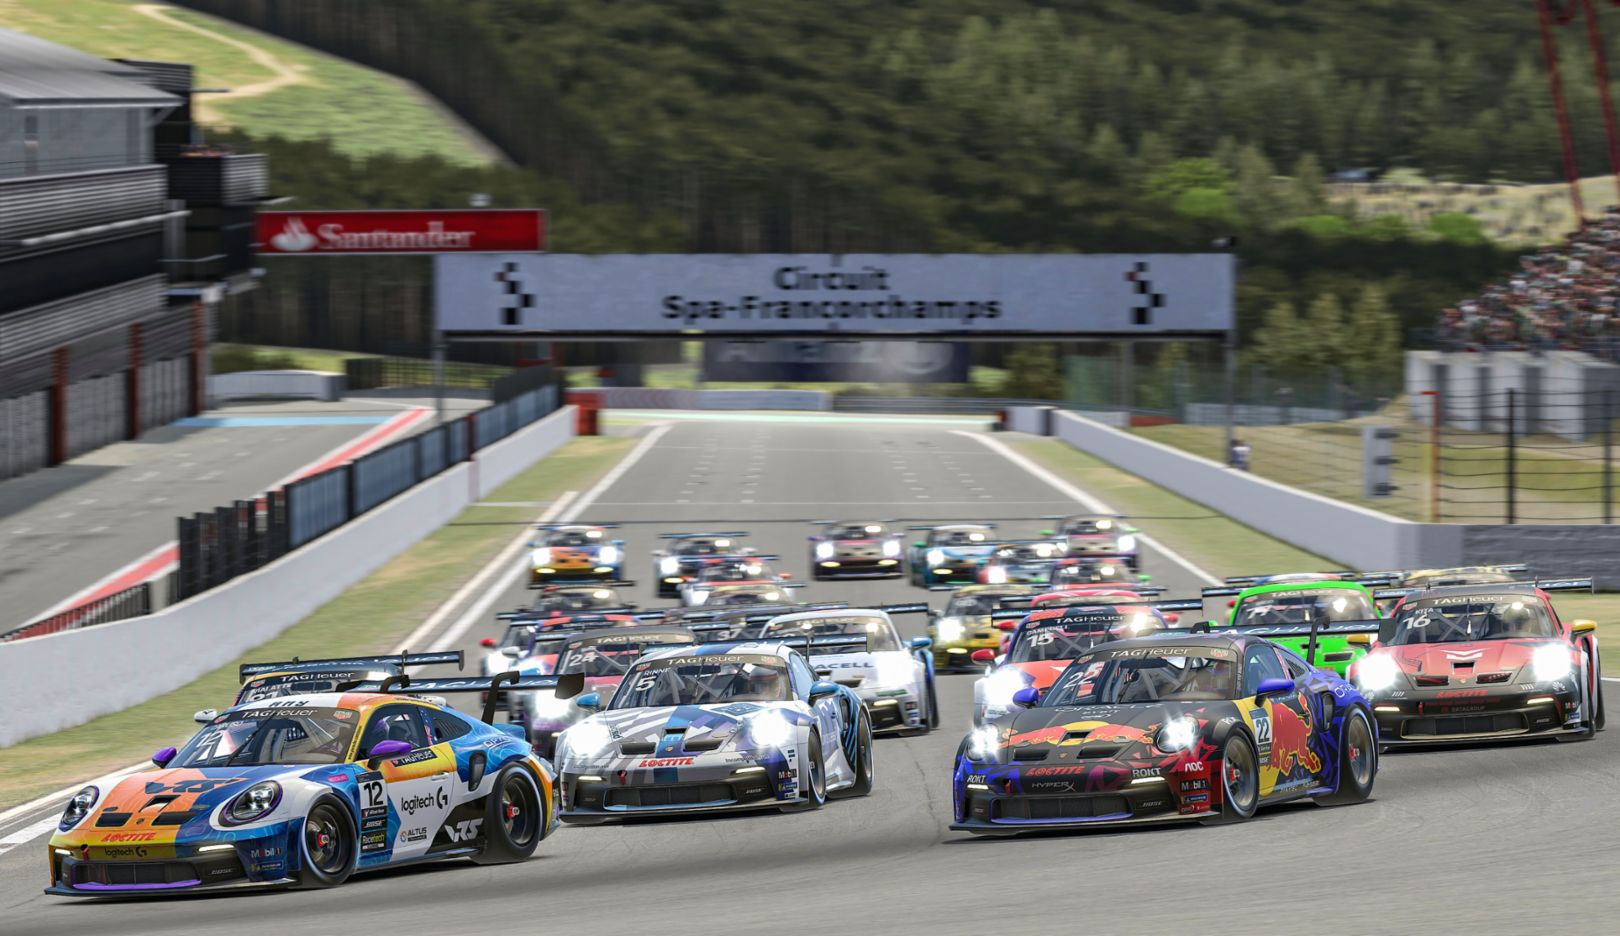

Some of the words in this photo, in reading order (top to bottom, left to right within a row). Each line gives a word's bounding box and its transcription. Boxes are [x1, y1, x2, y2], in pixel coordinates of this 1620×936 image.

[317, 221, 475, 248] Santander
[774, 266, 890, 290] Circuit
[662, 295, 1002, 325] Spa-Francorchamps
[1403, 615, 1431, 630] 16
[717, 628, 742, 640] 37
[1027, 633, 1054, 648] 15
[569, 652, 599, 666] 24
[635, 676, 656, 691] 5
[1256, 718, 1271, 743] 22
[639, 757, 695, 768] LOCTITE
[1184, 761, 1204, 773] AOC
[1025, 766, 1086, 776] LOCTITE
[1132, 768, 1161, 777] ROKT
[967, 774, 987, 784] ROKT
[1032, 781, 1076, 792] HYPERX
[363, 782, 384, 807] 12
[401, 793, 435, 815] logitech
[101, 833, 157, 842] LOCTITE
[408, 827, 427, 836] ALTUS
[105, 848, 134, 858] logitech
